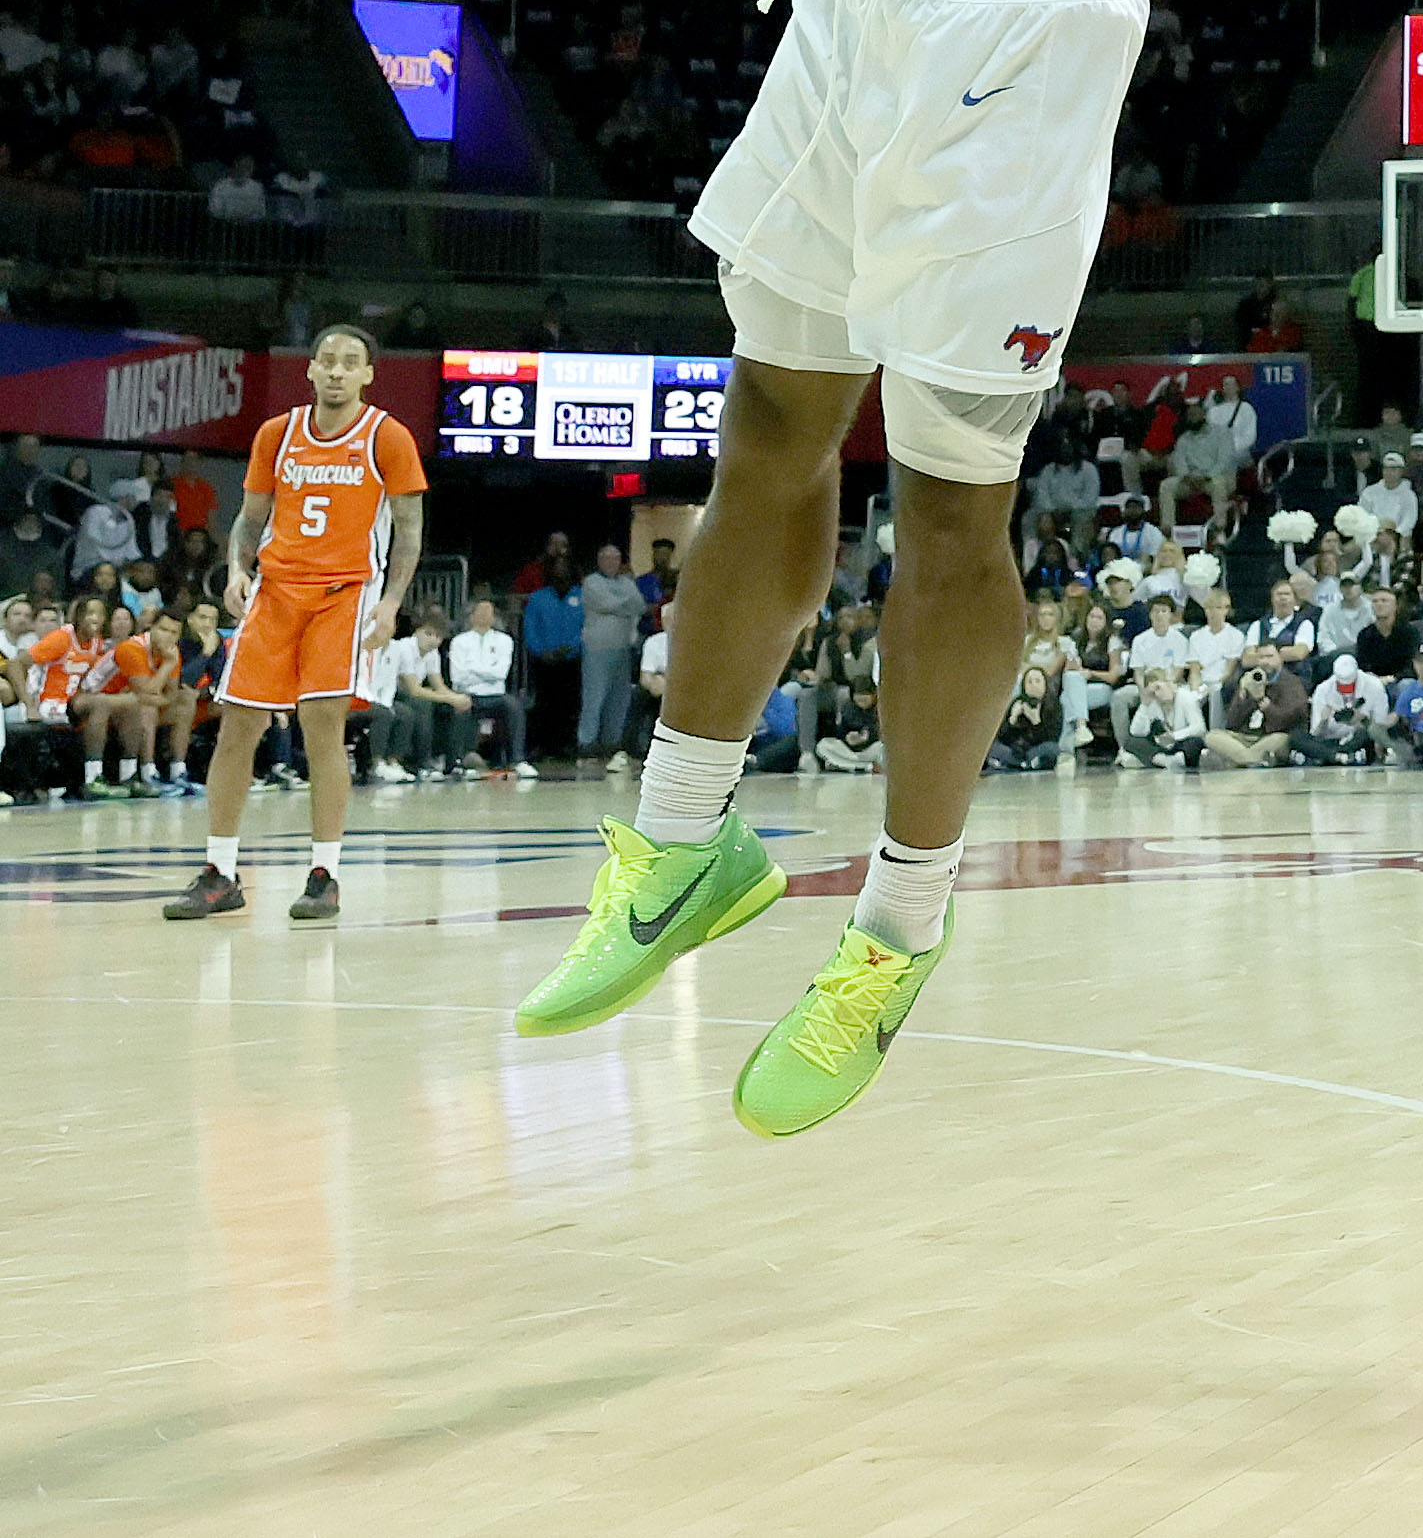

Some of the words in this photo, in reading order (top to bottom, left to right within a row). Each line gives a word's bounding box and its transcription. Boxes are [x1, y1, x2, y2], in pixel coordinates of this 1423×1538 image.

[468, 356, 518, 375] SMU
[551, 363, 587, 384] 1ST
[592, 364, 643, 385] HALF
[676, 362, 718, 381] SYR
[1262, 366, 1295, 384] 115
[103, 347, 244, 440] MUSTANGS
[459, 386, 524, 426] 18
[664, 390, 724, 430] 23
[556, 423, 632, 445] HOMES
[503, 436, 520, 455] 3
[281, 458, 365, 490] Syracuse
[300, 496, 331, 537] 5
